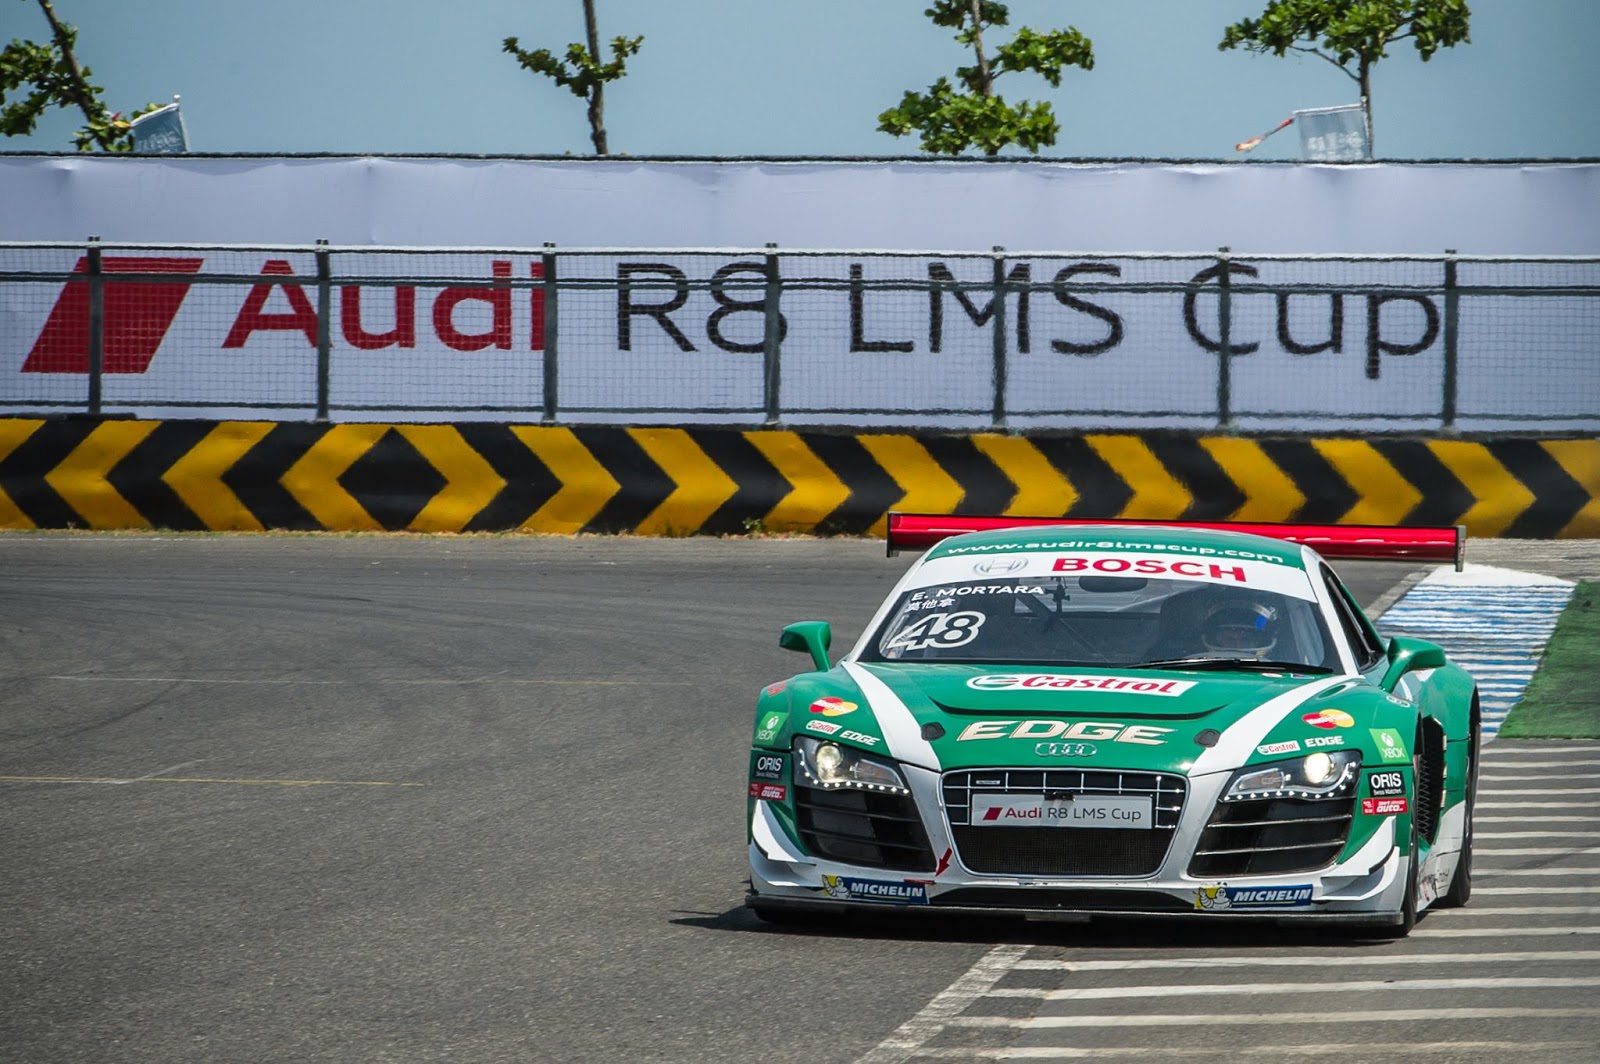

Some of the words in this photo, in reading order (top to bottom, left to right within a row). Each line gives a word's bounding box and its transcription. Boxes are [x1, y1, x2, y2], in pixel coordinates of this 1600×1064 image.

[221, 259, 546, 352] Audi
[617, 261, 787, 353] R8
[849, 262, 1125, 355] LMS
[1183, 262, 1440, 380] Cup
[947, 540, 1284, 564] www.audir8lmscup.com
[1051, 557, 1248, 583] BOSCH
[911, 591, 929, 601] E.
[936, 585, 1045, 598] MORTARA
[886, 610, 987, 652] 48
[1021, 675, 1179, 694] Castrol
[755, 729, 777, 741] XBOX
[839, 729, 881, 746] EDGE
[957, 720, 1178, 746] EDGE
[1268, 741, 1298, 753] Castrol
[1304, 735, 1345, 748] EDGE
[1382, 747, 1406, 759] XBOX
[757, 756, 783, 772] ORIS
[1370, 772, 1402, 789] ORIS
[1004, 807, 1042, 819] Audi
[1048, 807, 1068, 819] R8
[1073, 807, 1106, 820] LMS
[1111, 808, 1142, 822] Cup
[851, 882, 924, 897] MICHELIN
[1233, 888, 1312, 902] MICHELIN
